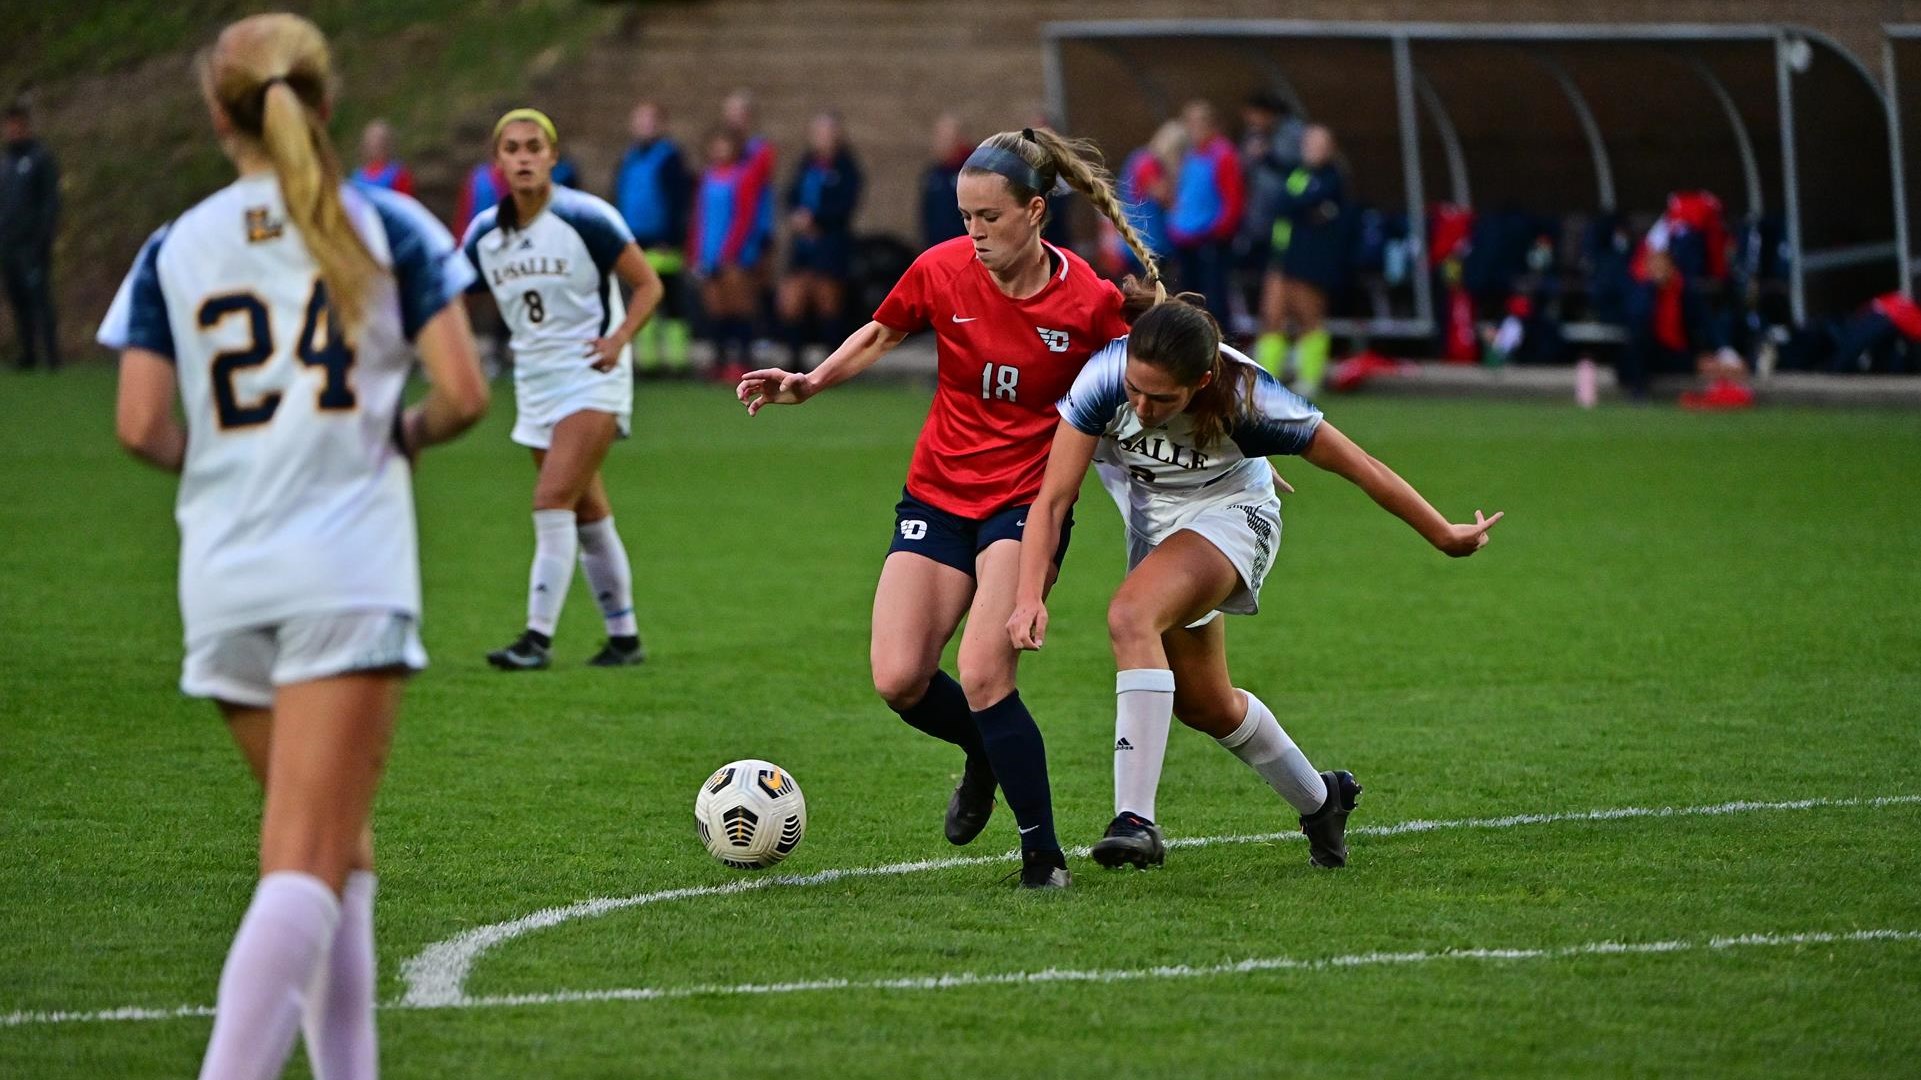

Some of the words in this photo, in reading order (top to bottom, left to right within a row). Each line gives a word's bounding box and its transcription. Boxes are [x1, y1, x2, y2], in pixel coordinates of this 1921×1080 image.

[523, 290, 544, 323] 8
[198, 275, 357, 431] 24
[982, 362, 1019, 402] 18
